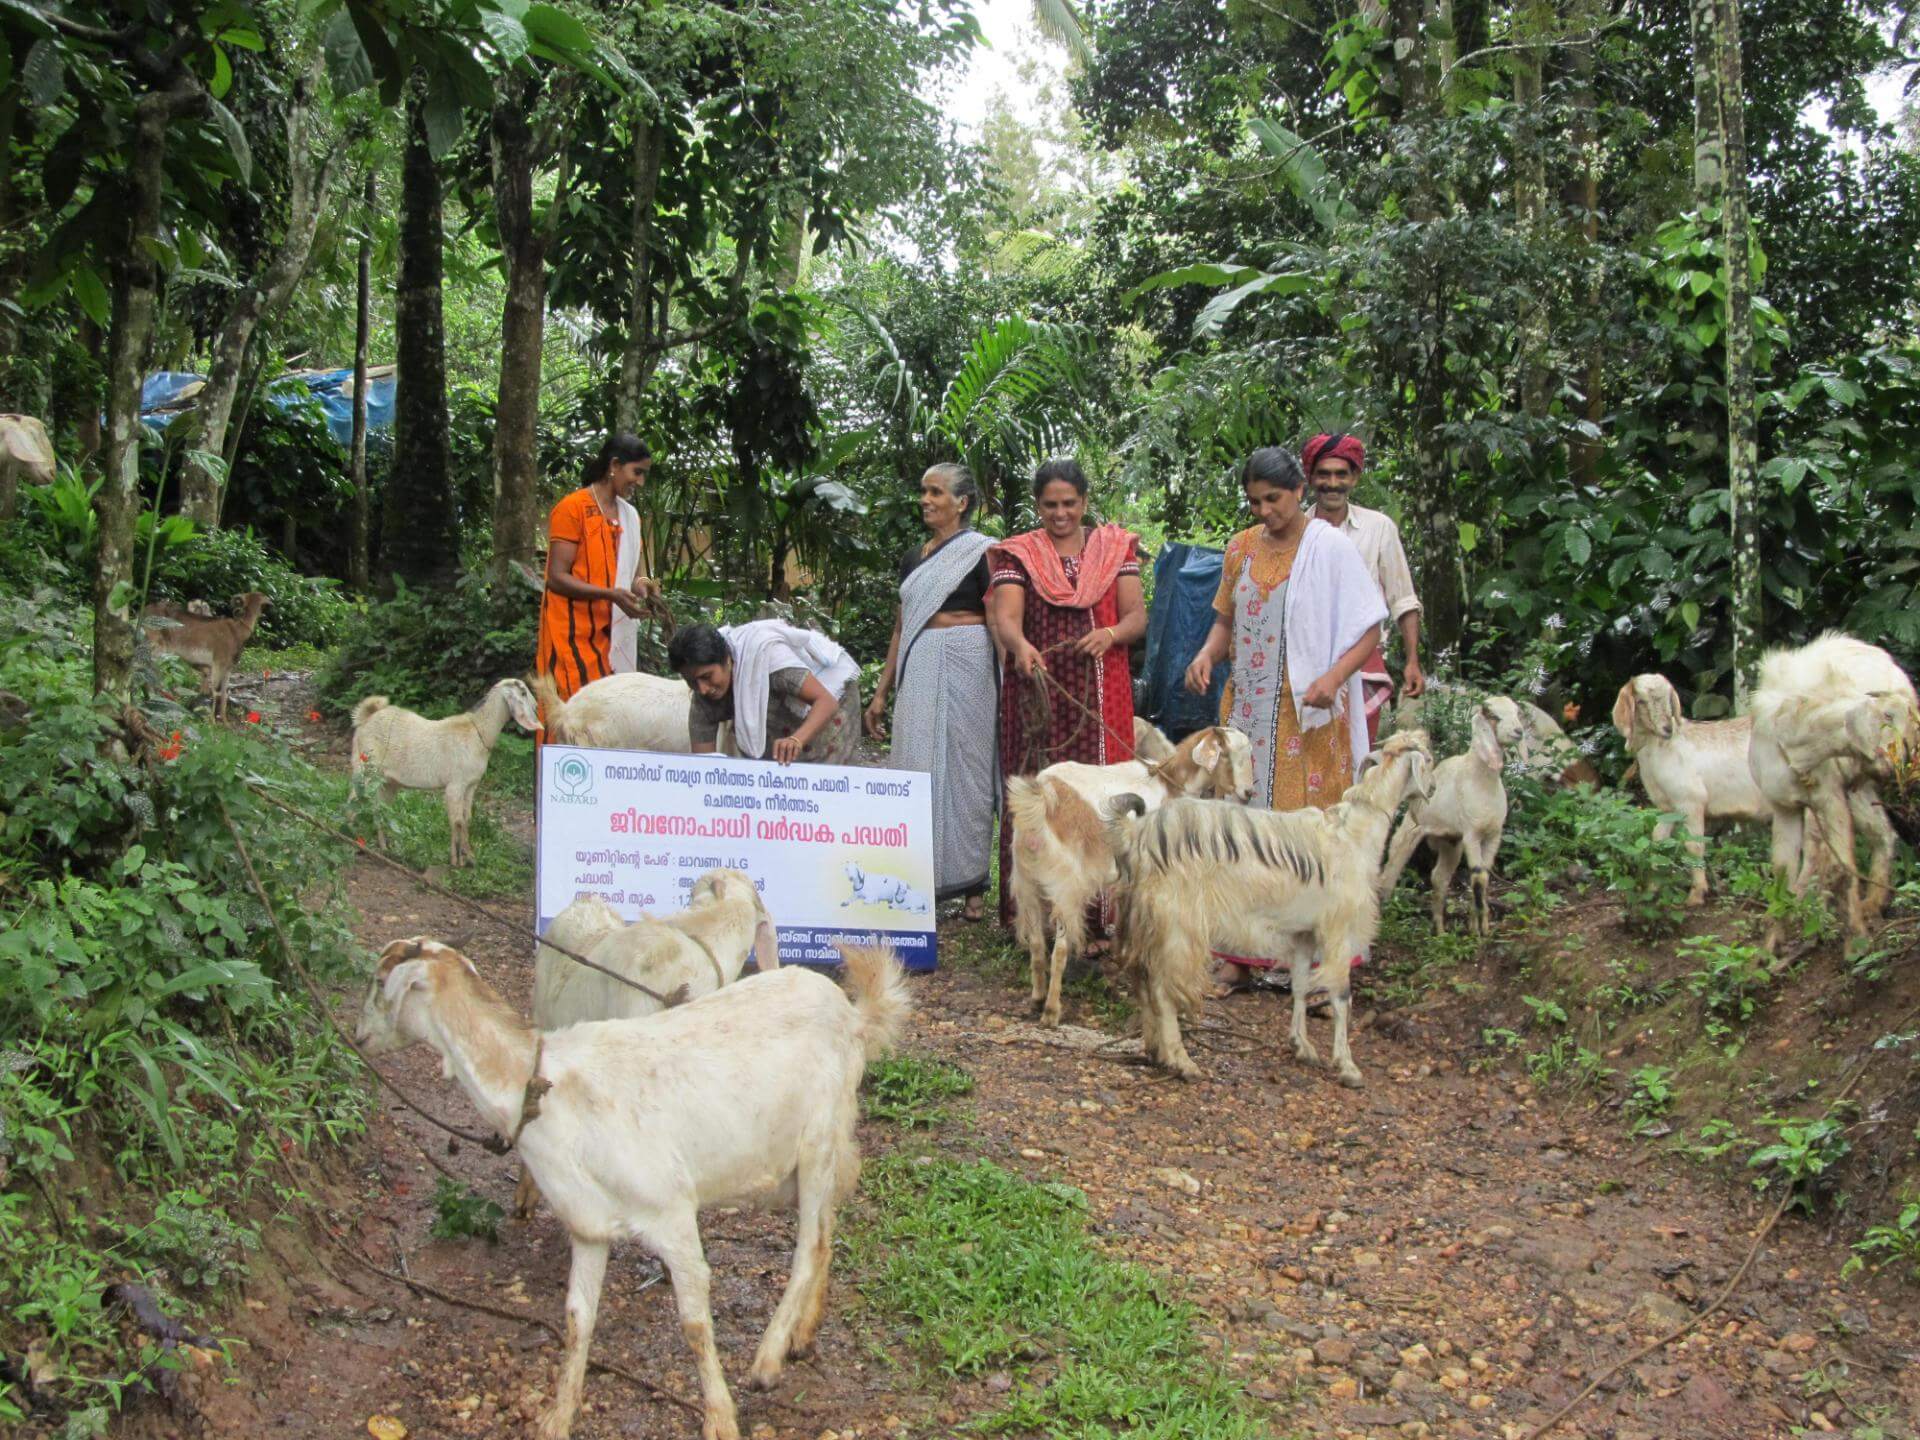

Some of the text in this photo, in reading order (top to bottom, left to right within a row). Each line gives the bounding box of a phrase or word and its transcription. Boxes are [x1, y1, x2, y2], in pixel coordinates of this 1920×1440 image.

[605, 764, 663, 782] നബാർഡ്
[665, 768, 700, 787] സമഗ്ര
[705, 767, 754, 787] നീർത്തട
[758, 771, 808, 790] വികസന
[812, 776, 849, 793] പദ്ധതി
[865, 780, 911, 797] വയനാട്
[550, 794, 598, 805] NABARD
[765, 793, 819, 813] നീർത്തടം
[610, 807, 908, 847] ജീവനോപാധി വർദ്ധക പദ്ധതി
[725, 858, 748, 869] JLG
[575, 871, 613, 885] പദ്ധതി
